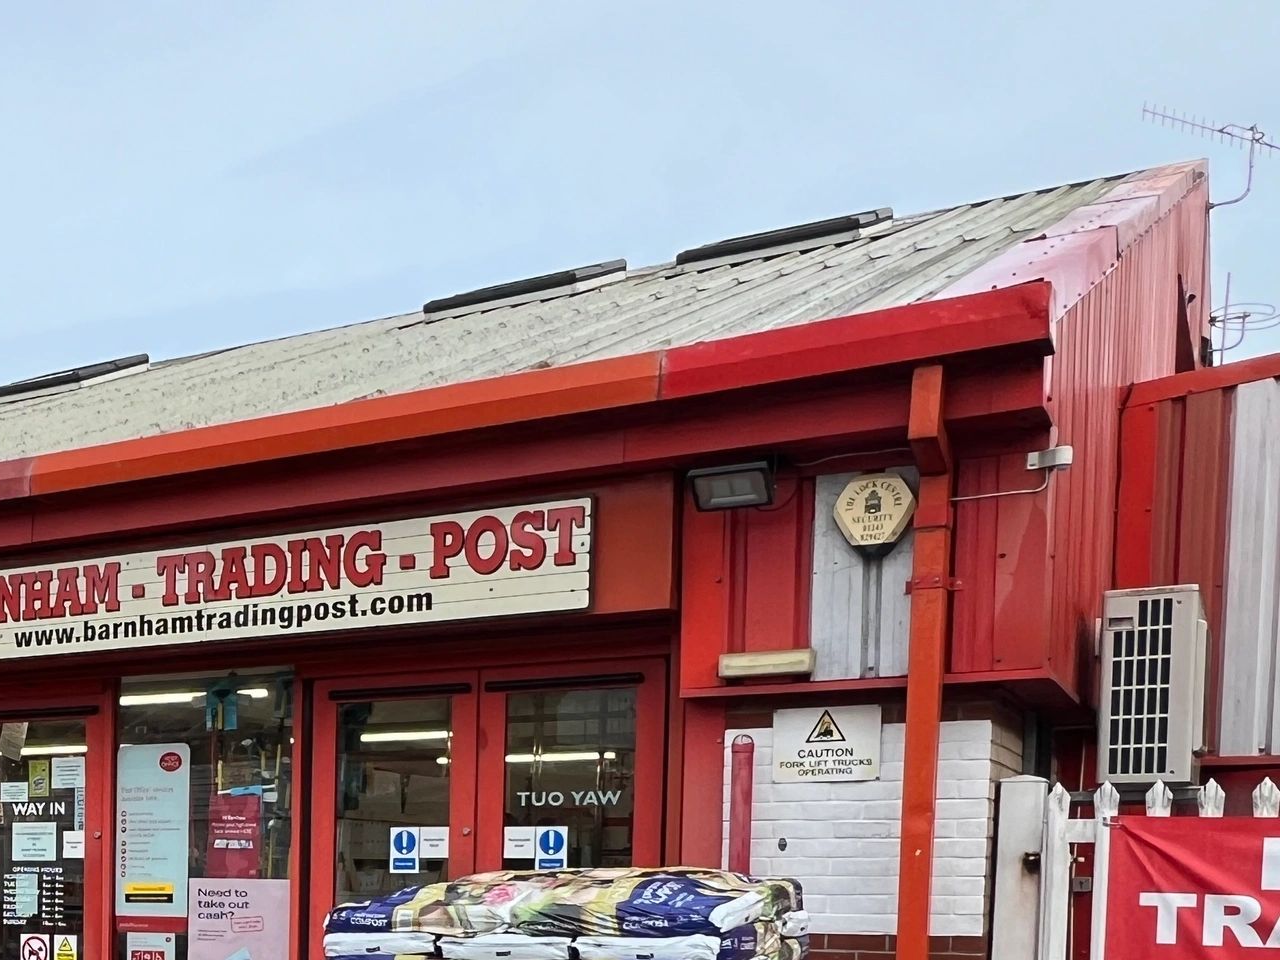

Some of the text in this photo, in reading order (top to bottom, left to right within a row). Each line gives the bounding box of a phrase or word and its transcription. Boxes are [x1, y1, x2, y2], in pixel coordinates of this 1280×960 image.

[157, 529, 386, 606] TRADING
[429, 505, 585, 579] POST
[14, 592, 433, 648] www.barnhamtradingpost.com
[797, 747, 854, 759] CAUTION
[779, 758, 873, 769] FORK LIFT TRUCKS
[797, 767, 853, 777] OPERATING
[12, 801, 65, 816] WAY IN
[197, 888, 248, 898] Need to
[197, 899, 250, 910] take out
[197, 910, 235, 920] cash?
[1138, 892, 1280, 949] TR
[350, 916, 388, 928] COMPOST
